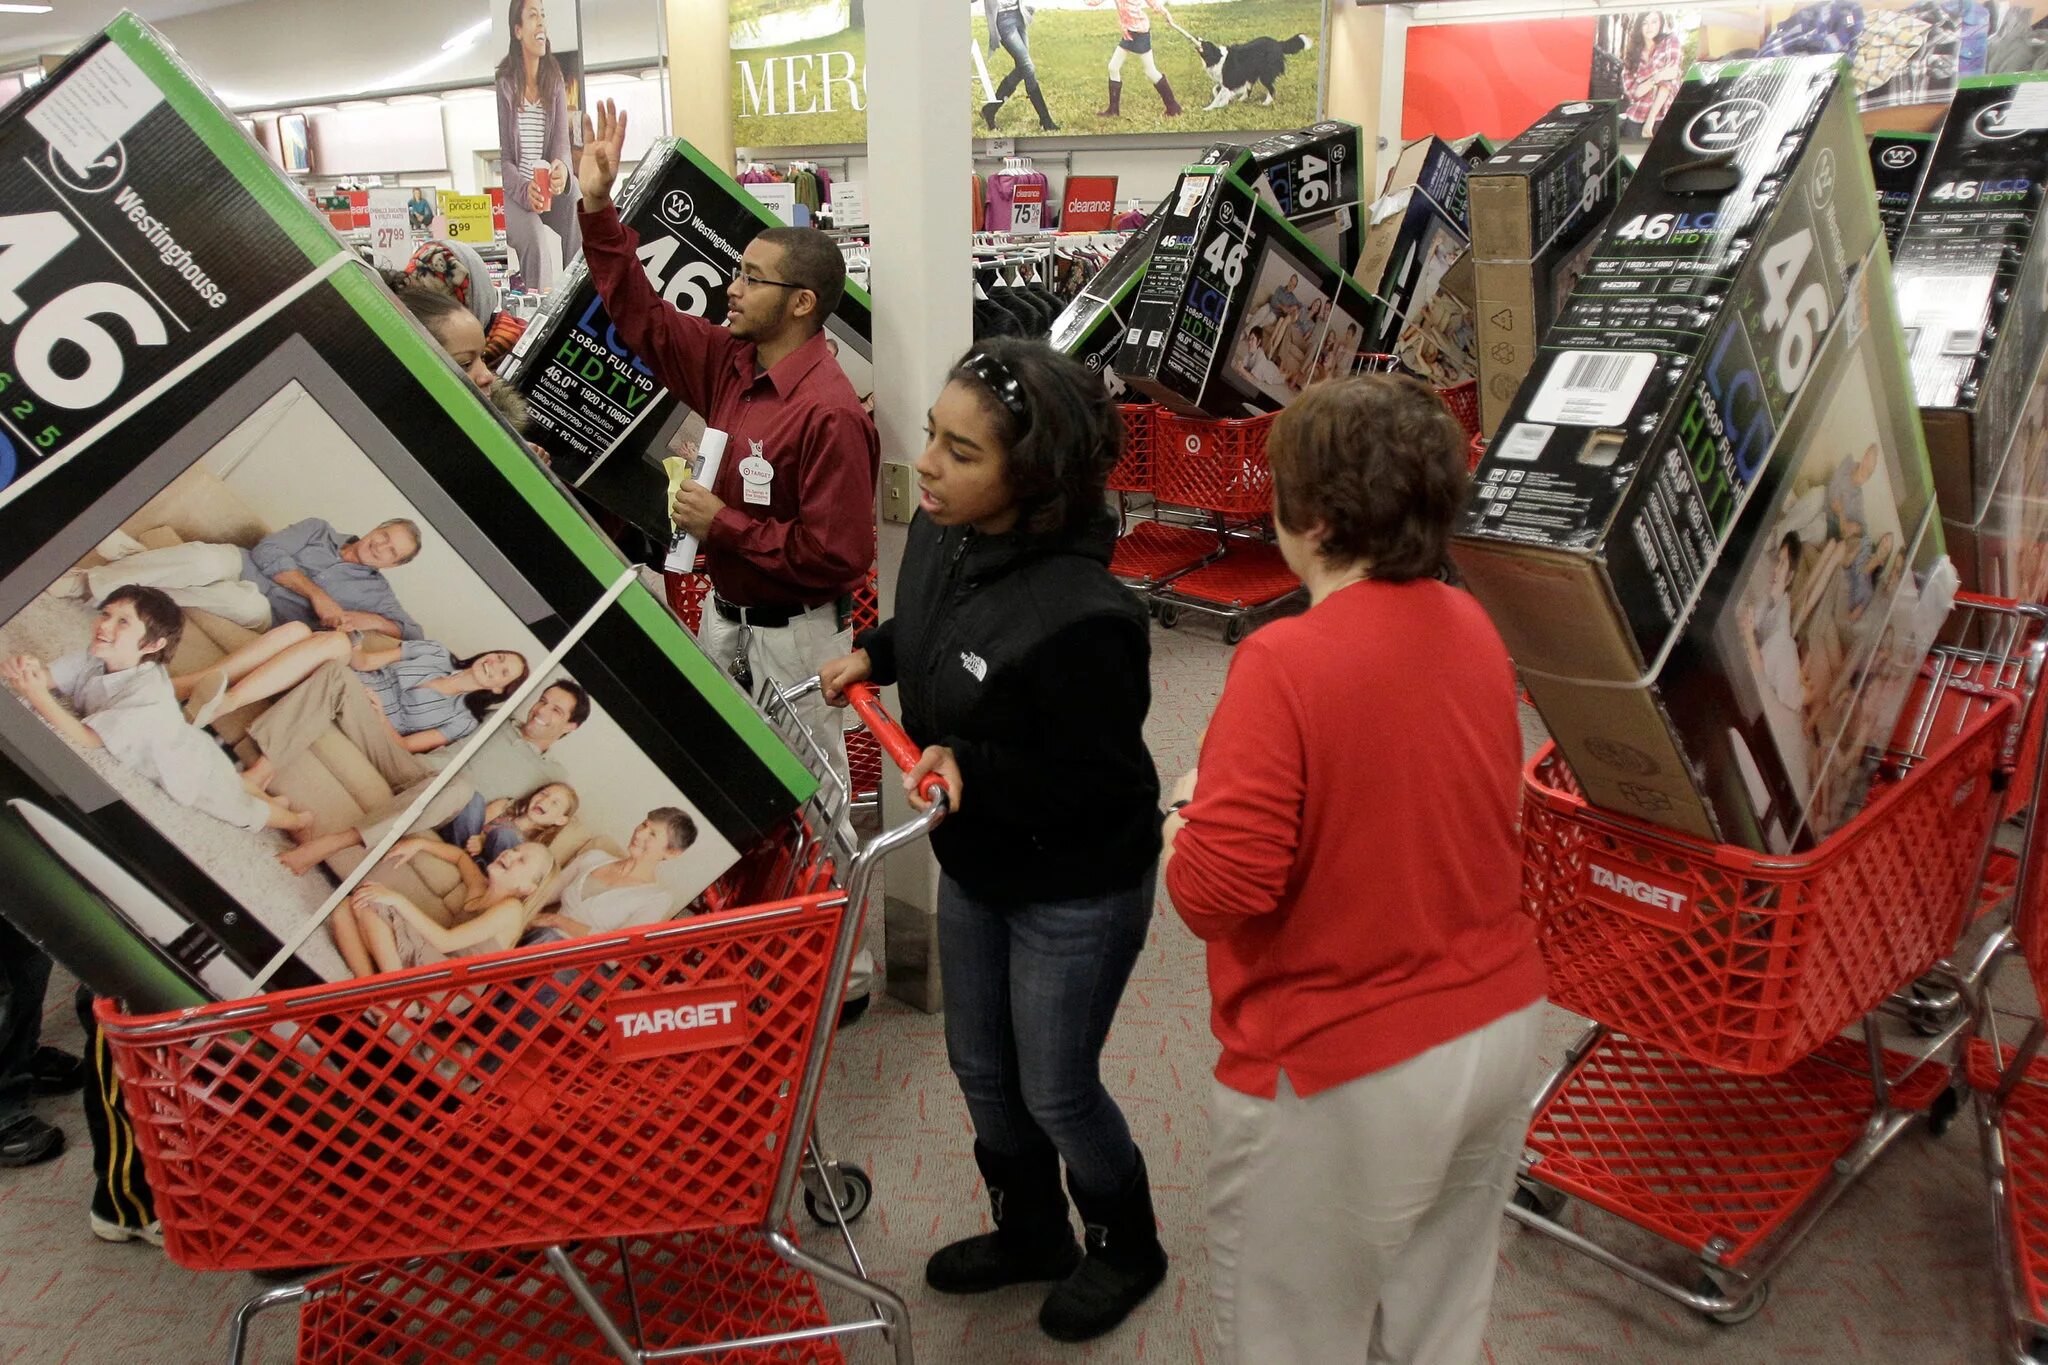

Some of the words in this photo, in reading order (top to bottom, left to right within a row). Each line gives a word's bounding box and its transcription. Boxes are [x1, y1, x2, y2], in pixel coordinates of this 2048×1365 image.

[449, 200, 471, 212] price
[472, 202, 487, 210] cut
[1016, 190, 1040, 198] clearance
[1068, 198, 1111, 213] clearance
[1298, 154, 1330, 208] 46
[1933, 181, 1979, 200] 46
[1983, 179, 2030, 190] LCD
[113, 185, 228, 309] Westinghouse
[448, 222, 471, 237] 899
[691, 215, 742, 262] Westinghouse
[1161, 235, 1177, 247] 46
[1616, 213, 1675, 240] 46
[635, 235, 723, 317] 46
[1203, 231, 1249, 288] 46
[0, 210, 168, 410] 46
[577, 296, 654, 376] LC
[1761, 228, 1828, 393] 46
[556, 338, 648, 409] HDTV
[569, 328, 607, 356] 1080P
[606, 353, 633, 380] FULL
[634, 375, 654, 391] HD
[540, 375, 569, 400] Viewable
[580, 404, 615, 432] Resolution
[545, 366, 578, 389] 46.0"
[580, 386, 600, 405] 1920
[607, 405, 631, 425] 1080P
[1708, 320, 1772, 482] LCD
[559, 431, 571, 442] PC
[569, 434, 588, 454] Input
[582, 425, 594, 435] HD
[1699, 381, 1723, 436] 1080P
[1719, 435, 1737, 485] FULL
[1589, 863, 1688, 913] TARGET
[615, 1000, 737, 1038] TARGET
